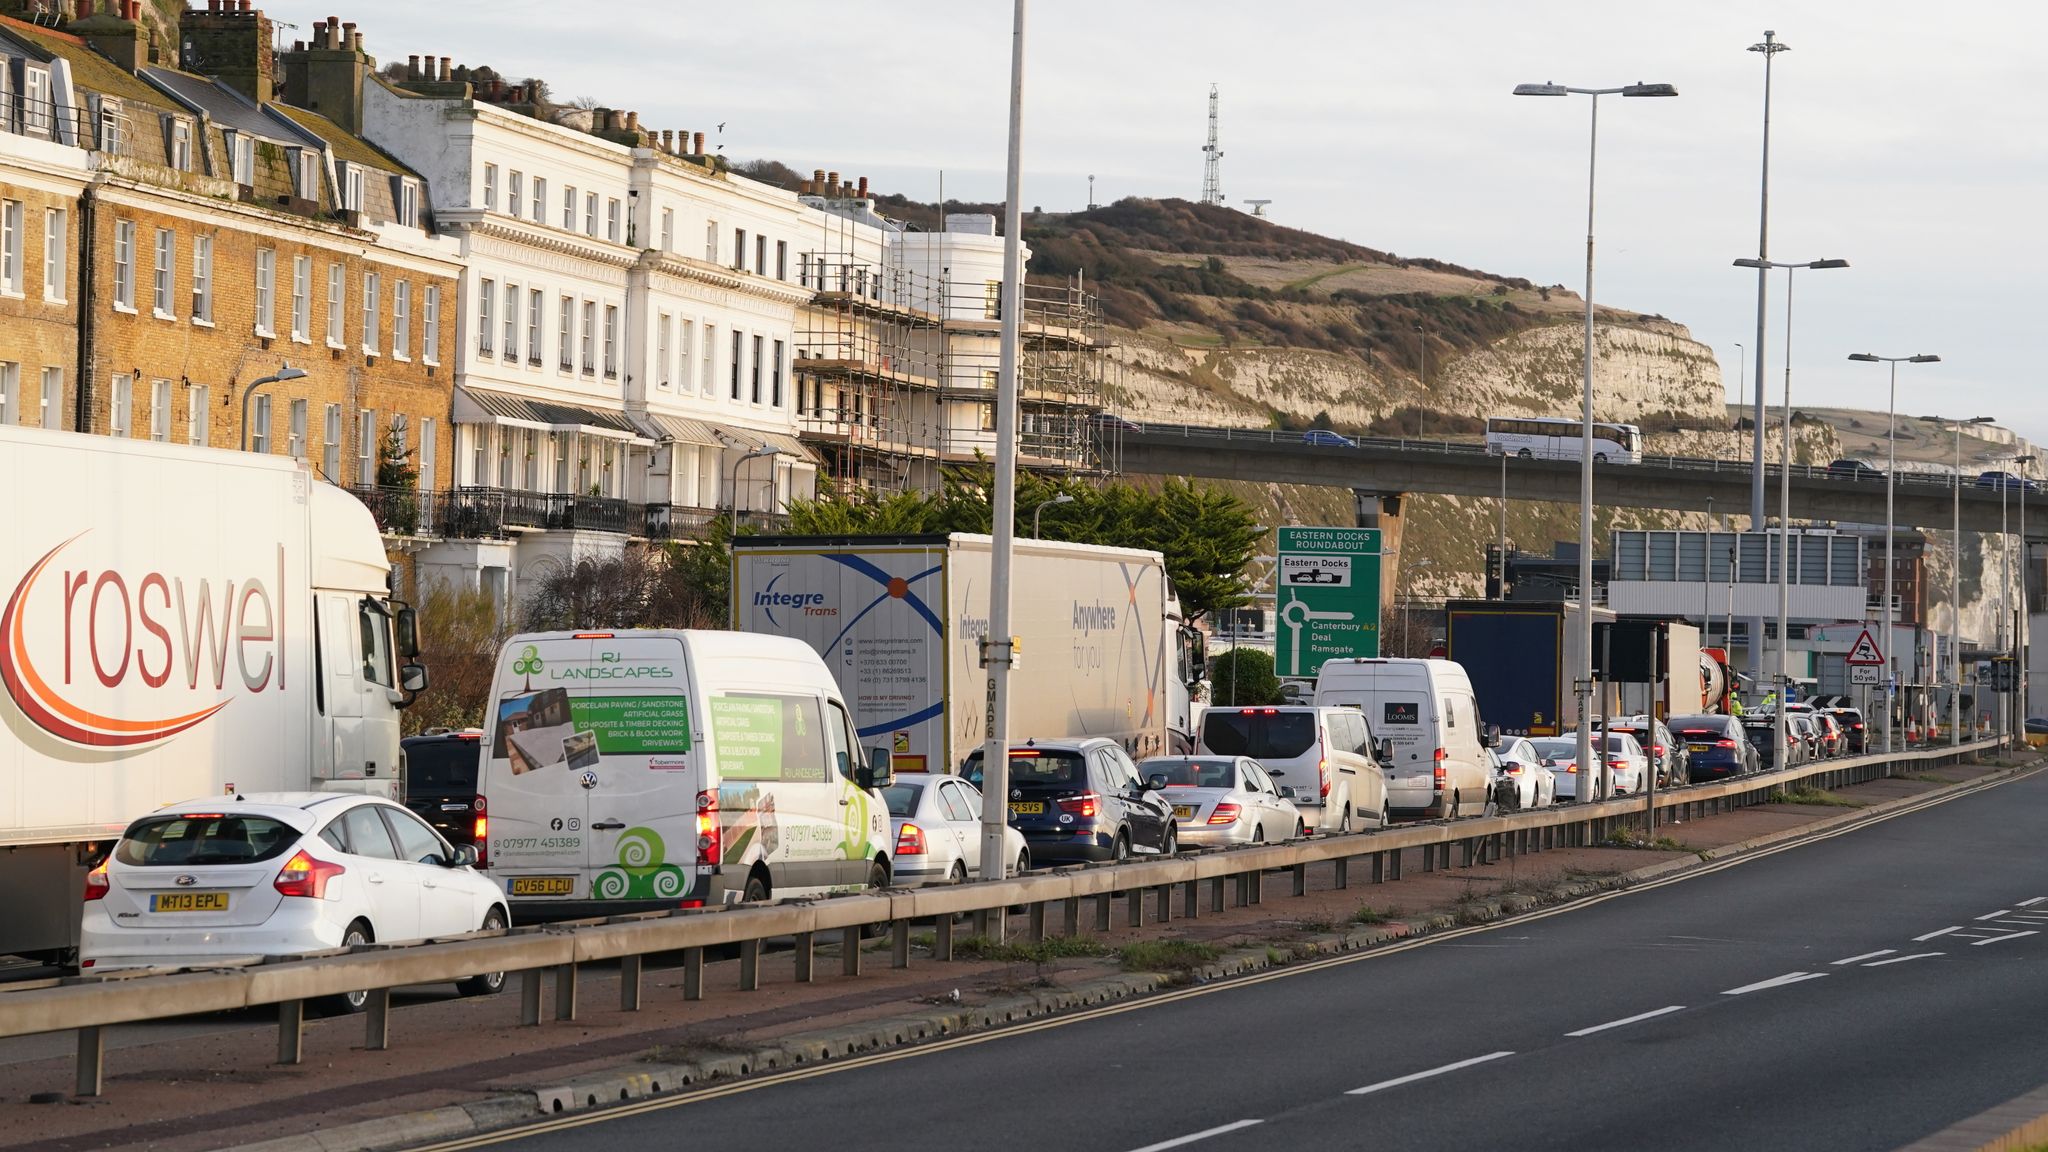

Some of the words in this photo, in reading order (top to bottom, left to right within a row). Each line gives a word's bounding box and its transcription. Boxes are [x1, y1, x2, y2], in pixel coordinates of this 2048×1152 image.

[1290, 531, 1333, 540] EASTERN
[1337, 532, 1370, 541] DOCKS
[1296, 541, 1364, 550] ROUNDABOUT
[1284, 558, 1318, 567] Eastern
[1322, 559, 1348, 568] Docks
[754, 592, 824, 608] Integre
[803, 607, 838, 616] Trans
[64, 542, 285, 694] roswel
[1073, 598, 1115, 638] Anywhere
[1311, 621, 1360, 632] Canterbury
[1363, 623, 1376, 631] A2
[1311, 633, 1331, 641] Deal
[1311, 644, 1354, 654] Ramsgate
[602, 652, 620, 663] RJ
[1085, 646, 1101, 677] you
[551, 666, 673, 679] LANDSCAPES
[572, 701, 609, 709] PORCELAIN
[642, 700, 684, 708] SANDSTONE
[579, 721, 618, 729] COMPOSITE
[1022, 803, 1040, 812] SVS
[502, 838, 537, 848] 07977
[541, 837, 580, 848] 451389
[515, 880, 545, 892] GV56
[547, 880, 570, 891] LCU
[161, 894, 192, 909] MT13
[195, 893, 222, 908] EPL
